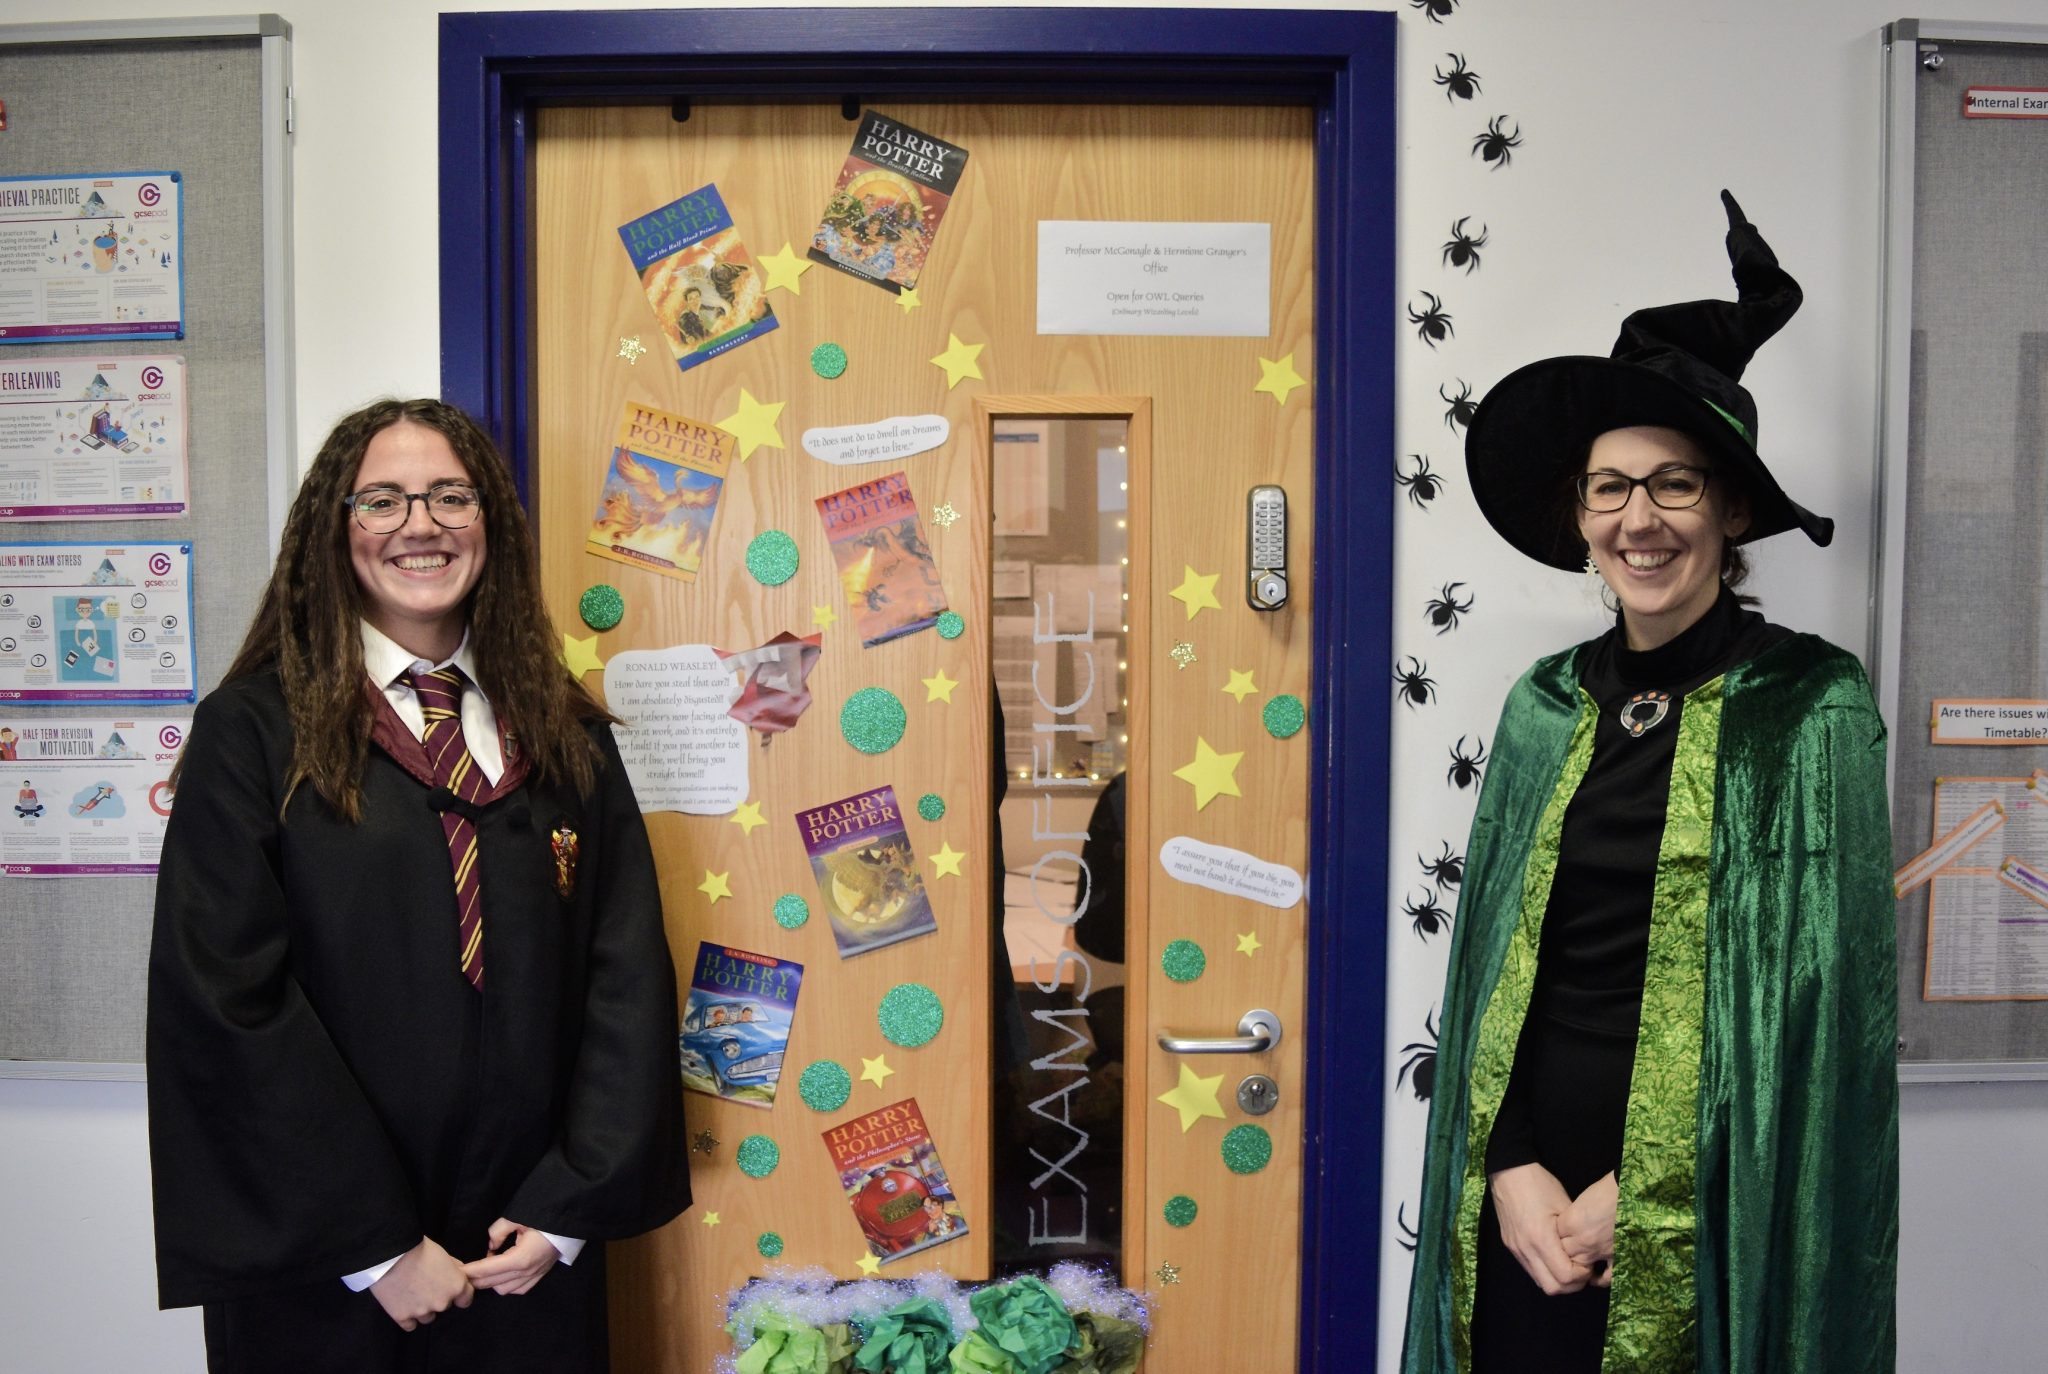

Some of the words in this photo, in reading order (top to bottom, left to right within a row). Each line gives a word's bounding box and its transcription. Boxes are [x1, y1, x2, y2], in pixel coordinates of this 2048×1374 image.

[1973, 97, 2019, 108] Internal
[871, 120, 951, 162] HARRY
[862, 135, 944, 180] POTTER
[0, 190, 30, 207] IEVAL
[32, 188, 80, 206] PRACTICE
[134, 208, 168, 219] gcsepod
[628, 191, 709, 241] HARRY
[633, 207, 720, 257] POTTER
[647, 252, 657, 260] and
[659, 247, 668, 255] the
[668, 240, 682, 250] Half
[682, 232, 698, 243] Blood
[699, 225, 717, 236] Prince
[1064, 244, 1101, 257] Professor
[1153, 247, 1161, 256] &
[1164, 246, 1203, 256] Hermione
[1206, 247, 1247, 259] Granger's
[1143, 261, 1168, 275] Office
[1106, 292, 1129, 303] Open
[1131, 289, 1144, 304] for
[1145, 292, 1170, 302] OWL
[1171, 292, 1204, 303] Queries
[0, 371, 61, 390] ERLEAVING
[138, 392, 171, 401] gcsepod
[635, 409, 726, 446] HARRY
[822, 436, 838, 447] does
[840, 435, 854, 444] not
[856, 432, 865, 442] do
[867, 433, 875, 441] to
[877, 425, 898, 440] dwell
[912, 424, 942, 435] dreams
[629, 424, 722, 464] POTTER
[840, 450, 855, 459] and
[856, 446, 880, 460] forget
[882, 445, 890, 453] to
[823, 477, 902, 512] HARRY
[828, 490, 914, 528] POTTER
[0, 555, 16, 567] LING
[18, 555, 35, 567] WITH
[37, 555, 54, 566] EXAM
[57, 554, 82, 566] STRESS
[144, 578, 178, 588] gcsepod
[625, 663, 667, 672] RONALD
[614, 680, 633, 688] How
[635, 679, 652, 688] dare
[655, 681, 669, 690] you
[672, 676, 690, 687] steal
[693, 676, 709, 687] that
[641, 694, 682, 707] absolutely
[640, 710, 669, 724] father's
[691, 710, 716, 722] facing
[1941, 707, 1961, 718] Are
[1965, 707, 1995, 718] there
[1999, 708, 2033, 719] issues
[2036, 710, 2048, 719] wi
[22, 729, 38, 739] HALF
[40, 729, 59, 739] TERM
[61, 728, 93, 739] REVISION
[641, 728, 649, 736] at
[675, 727, 690, 736] and
[705, 724, 738, 737] entirely
[1984, 727, 2048, 738] Timetable?
[40, 740, 94, 756] MOTIVATION
[662, 744, 677, 753] you
[695, 738, 725, 750] another
[155, 752, 178, 761] gcsep
[624, 757, 637, 765] out
[639, 755, 647, 767] of
[687, 753, 709, 767] bring
[710, 757, 726, 767] you
[1030, 590, 1095, 922] OFFICE
[646, 769, 676, 781] straight
[805, 790, 887, 828] HARRY
[809, 806, 897, 843] POTTER
[1174, 861, 1192, 872] need
[1193, 868, 1205, 877] not
[1207, 868, 1227, 882] hand
[1228, 876, 1234, 885] it
[1181, 851, 1206, 863] assure
[1207, 857, 1223, 868] you
[1224, 859, 1241, 873] that
[1242, 864, 1249, 877] if
[1249, 869, 1265, 881] you
[1279, 879, 1295, 889] you
[705, 953, 794, 986] HARRY
[702, 967, 787, 1001] POTTER
[1028, 950, 1092, 1247] EXAMS
[831, 1103, 912, 1144] HARRY
[835, 1118, 923, 1159] POTTER
[856, 1153, 866, 1161] the
[905, 1134, 921, 1142] Stone
